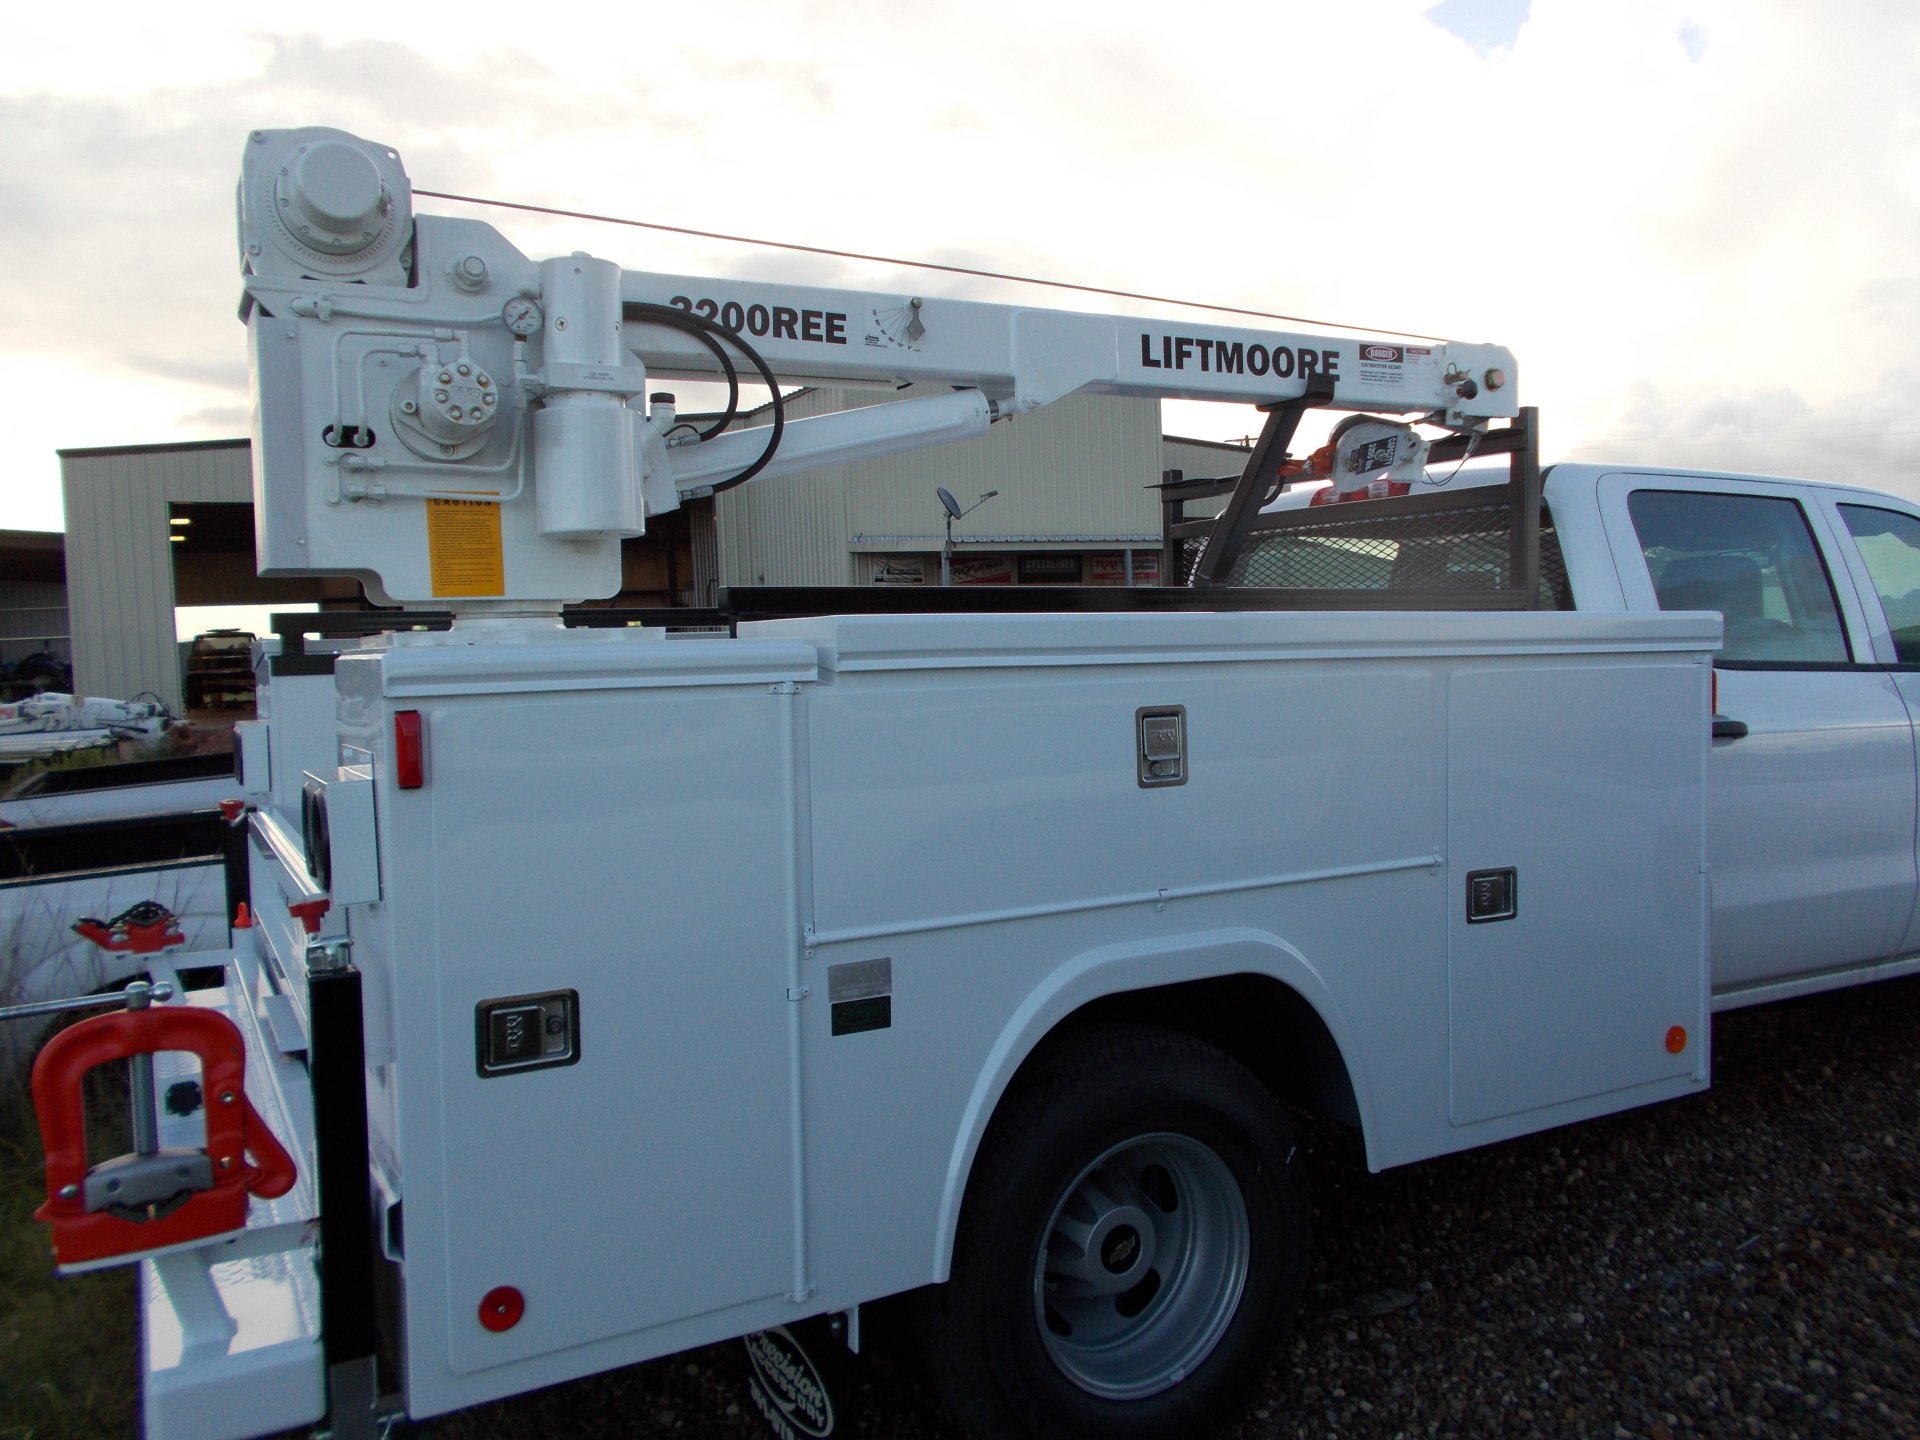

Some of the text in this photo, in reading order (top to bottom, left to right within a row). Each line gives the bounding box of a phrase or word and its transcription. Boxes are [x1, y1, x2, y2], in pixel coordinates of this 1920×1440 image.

[1141, 333, 1340, 382] LIFTMOORE
[1370, 348, 1393, 359] DANGER
[1366, 443, 1377, 460] 3200
[751, 1332, 824, 1408] recision
